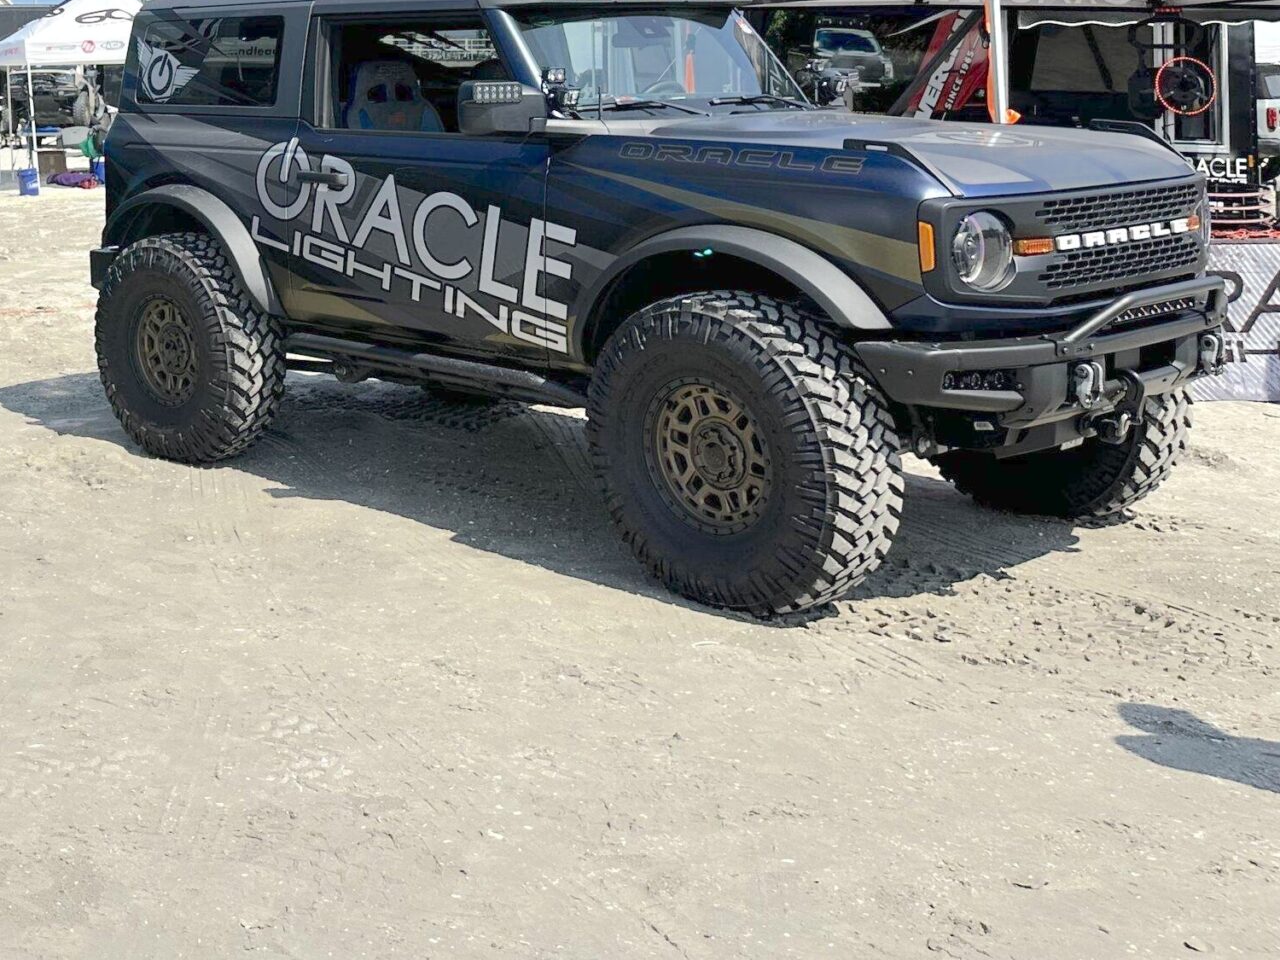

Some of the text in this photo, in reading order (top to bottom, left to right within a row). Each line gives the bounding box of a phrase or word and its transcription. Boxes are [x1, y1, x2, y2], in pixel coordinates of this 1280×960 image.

[945, 50, 976, 110] SINCE 1965
[619, 142, 868, 175] ORACLE
[1187, 157, 1247, 178] ACLE
[255, 137, 577, 320] ORACLE
[1055, 217, 1193, 251] ORACLE
[251, 215, 569, 354] LIGHTING
